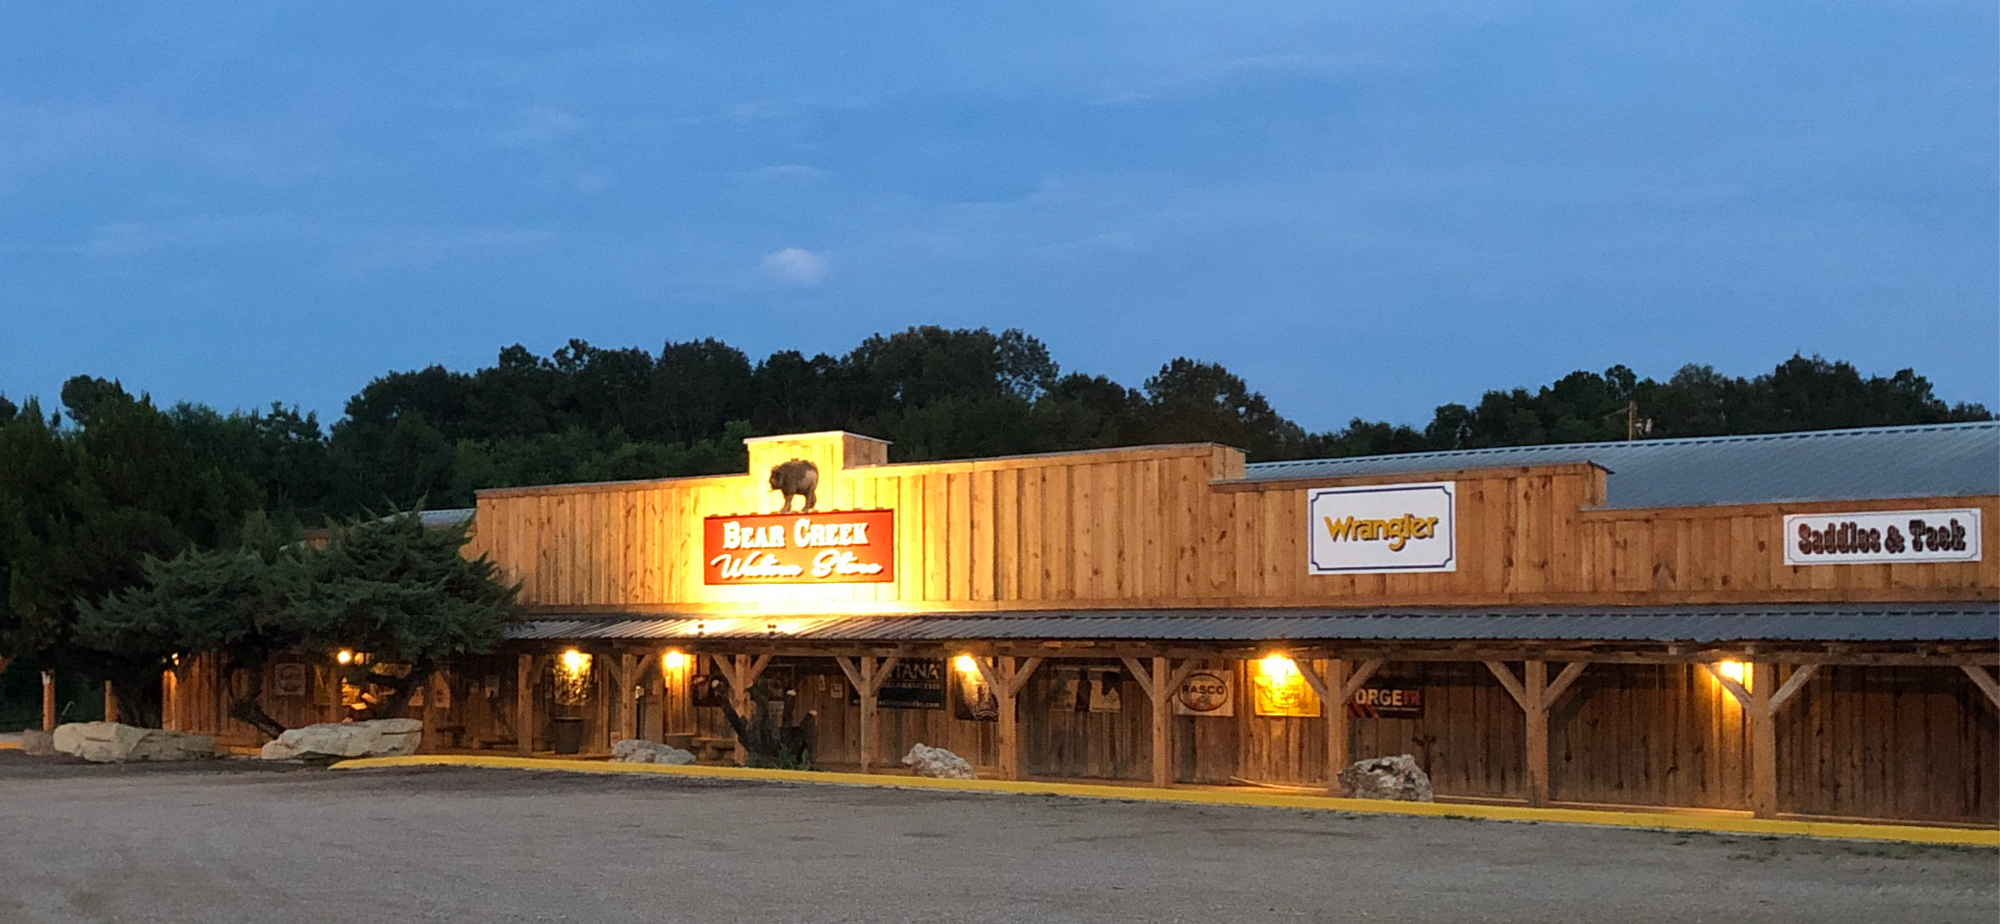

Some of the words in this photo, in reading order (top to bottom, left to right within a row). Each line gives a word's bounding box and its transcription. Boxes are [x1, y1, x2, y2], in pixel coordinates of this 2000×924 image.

[723, 521, 785, 549] BEAR
[794, 518, 869, 547] CREEK
[1324, 513, 1438, 552] Wrangler
[1798, 522, 1881, 555] Saddles
[1884, 525, 1906, 553] &
[1909, 518, 1967, 552] Tack
[889, 663, 940, 680] TANA
[1182, 685, 1225, 694] RASCO
[1354, 688, 1402, 706] ORGE
